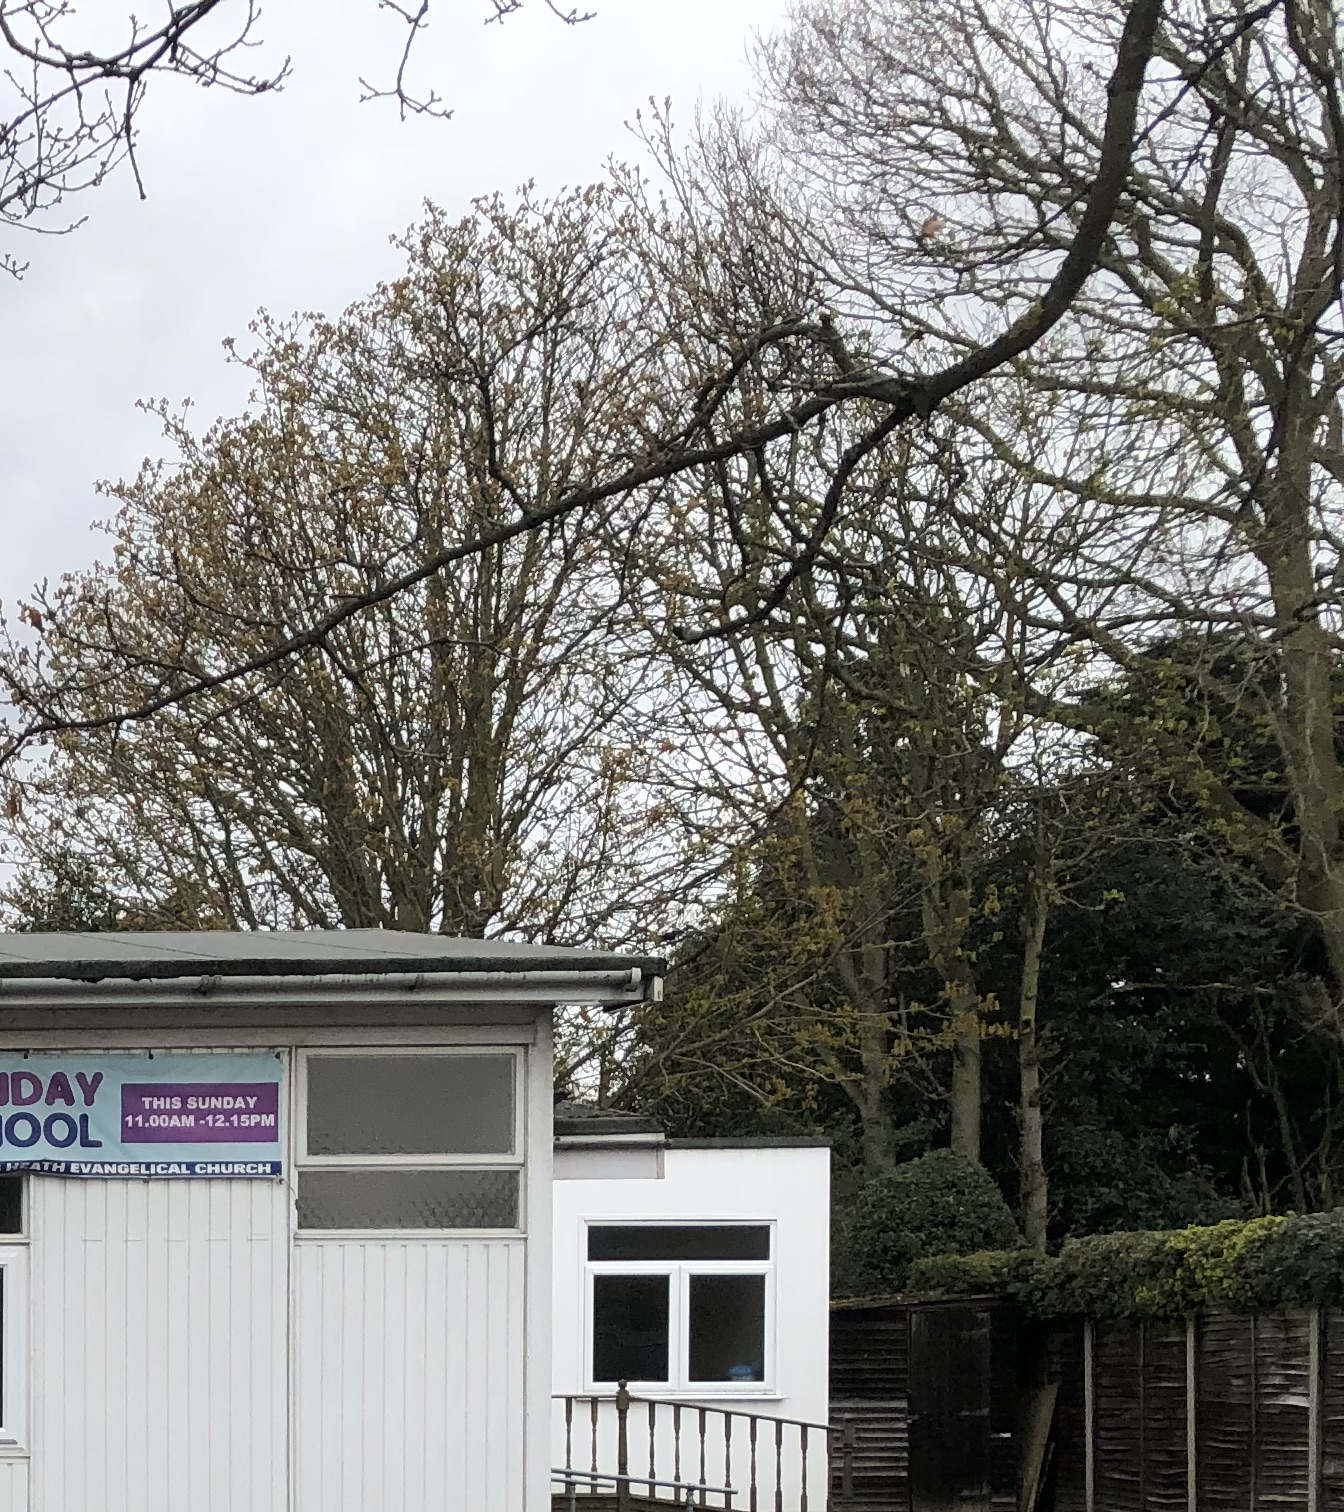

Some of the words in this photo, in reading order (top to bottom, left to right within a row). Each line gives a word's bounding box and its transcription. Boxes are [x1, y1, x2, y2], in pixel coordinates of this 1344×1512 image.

[141, 1096, 182, 1109] THIS
[186, 1096, 258, 1109] SUNDAY
[124, 1114, 195, 1127] 11.00AM
[69, 1162, 191, 1175] EVANGELICAL
[194, 1162, 272, 1174] CHURCH
